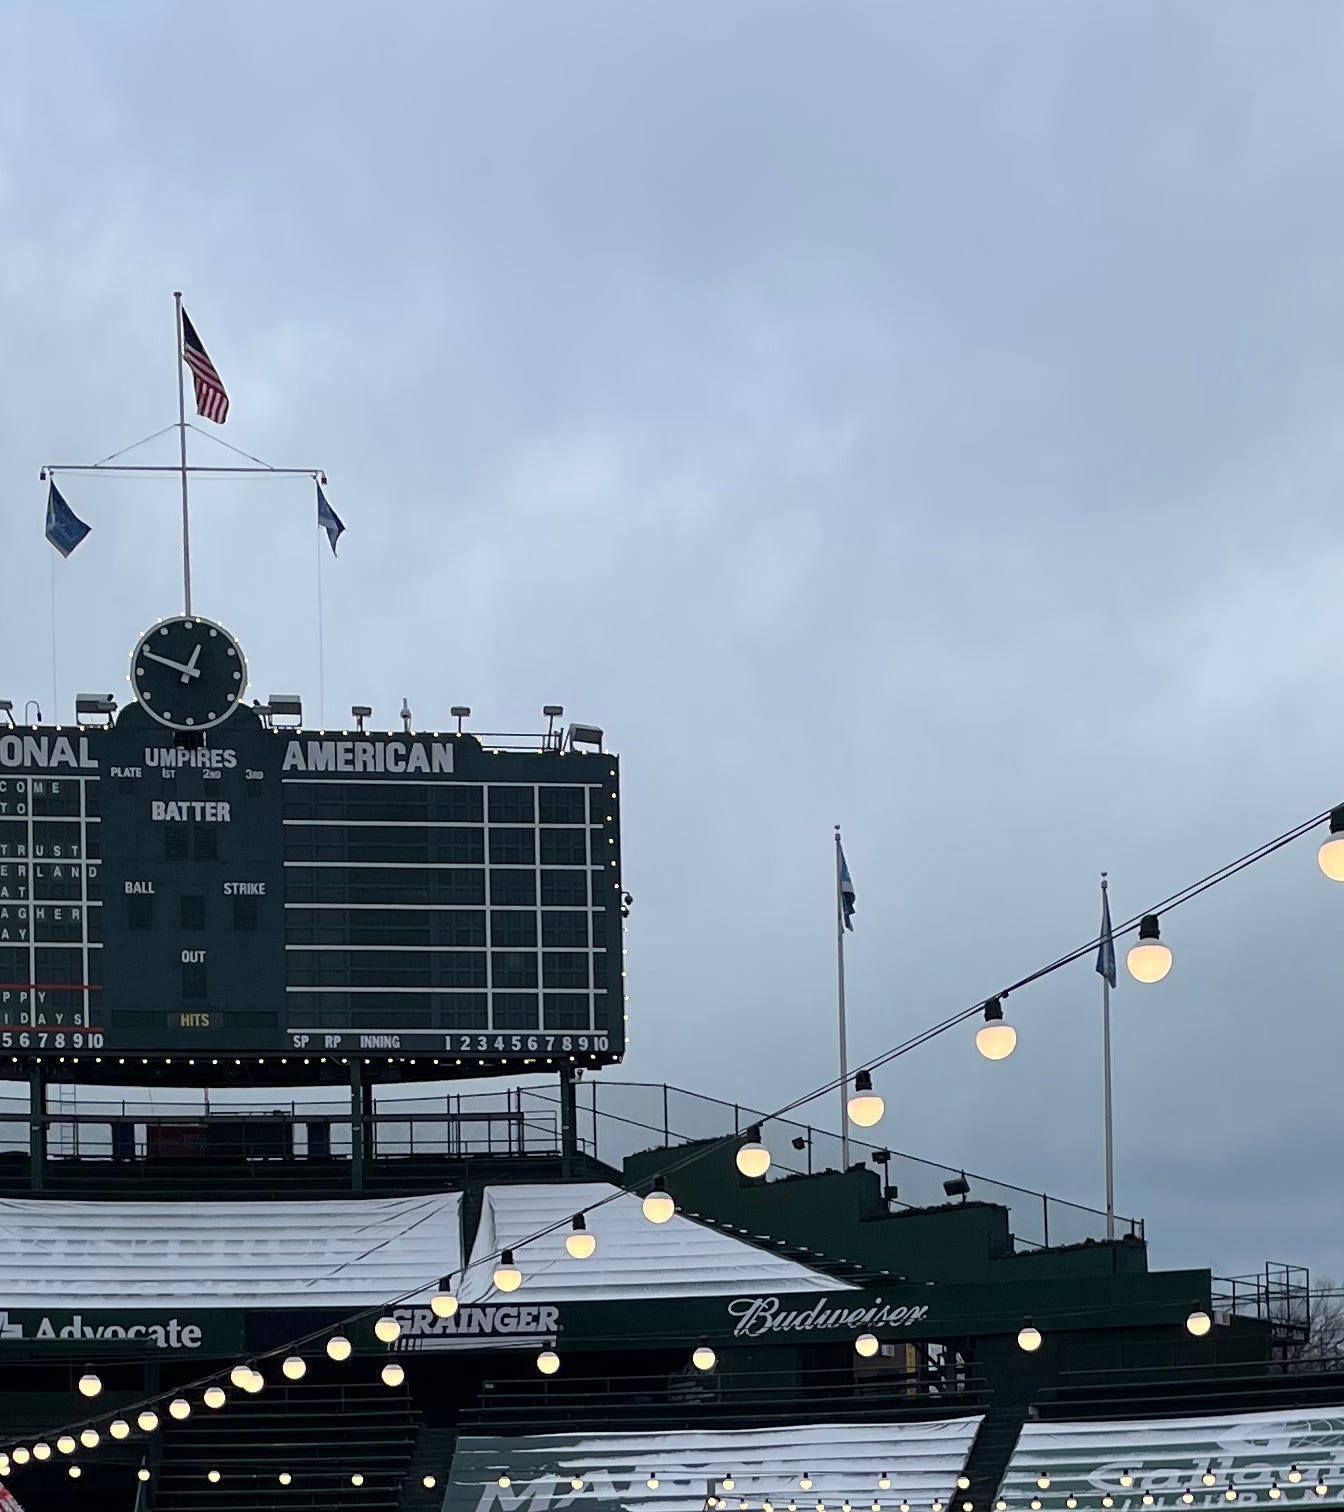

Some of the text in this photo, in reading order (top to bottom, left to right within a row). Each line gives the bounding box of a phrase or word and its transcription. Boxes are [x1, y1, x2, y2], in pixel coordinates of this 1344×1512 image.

[144, 747, 238, 768] UMPIRES
[282, 740, 454, 773] AMERICAN
[110, 766, 143, 778] PLATE
[0, 802, 26, 814] TO
[151, 801, 231, 822] BATTER
[0, 886, 27, 898] AT
[124, 881, 156, 894] BALL
[223, 882, 266, 895] STRIKE
[181, 950, 206, 963] OUT
[180, 1013, 210, 1027] HITS
[2, 1032, 13, 1049] 5
[19, 1032, 31, 1049] 6
[37, 1032, 49, 1049] 7
[54, 1032, 66, 1049] 8
[72, 1032, 84, 1049] 9
[87, 1032, 105, 1049] 10
[293, 1034, 609, 1051] SP RP INNING 1 2 3 4 5 6 7 8 9 10
[392, 1306, 560, 1336] GRAINGER
[728, 1296, 929, 1338] Budweiser
[36, 1314, 203, 1349] Advocate
